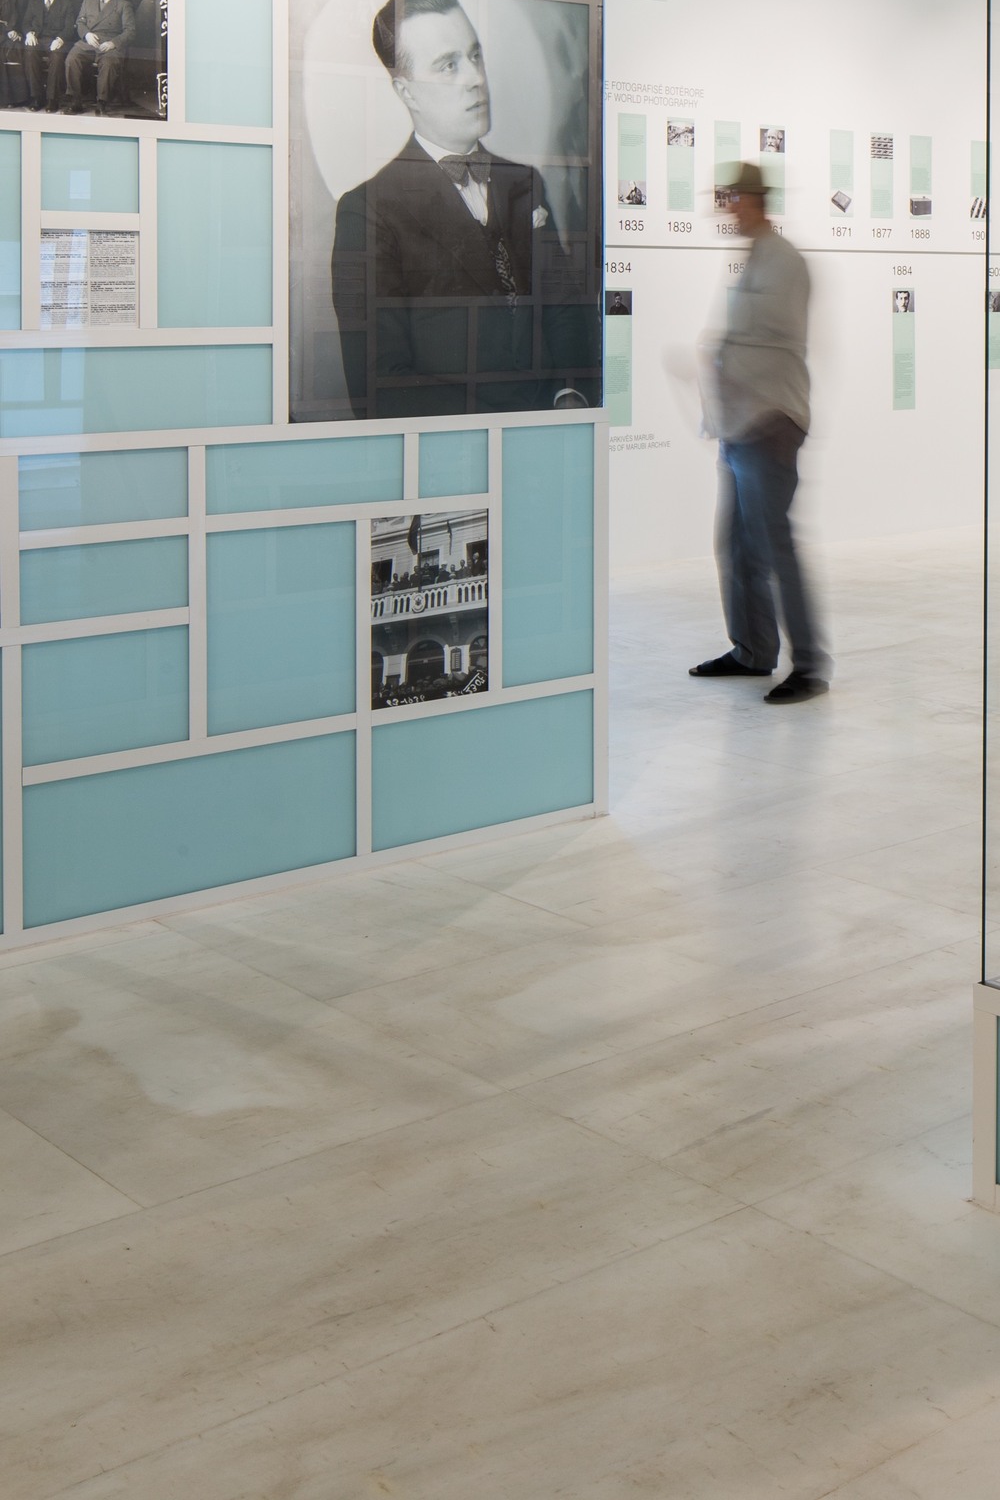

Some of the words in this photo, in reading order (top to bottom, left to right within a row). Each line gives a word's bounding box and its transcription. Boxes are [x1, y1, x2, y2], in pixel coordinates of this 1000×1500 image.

[614, 93, 641, 104] WORLD
[644, 96, 699, 108] PHOTOGRAPHY
[619, 220, 644, 231] 1835
[668, 221, 692, 233] 1839
[831, 226, 852, 237] 1871
[872, 228, 892, 239] 1877
[911, 229, 930, 239] 1888
[972, 231, 985, 240] 190
[605, 262, 632, 273] 1834
[728, 263, 745, 274] 185
[892, 266, 912, 275] 1884
